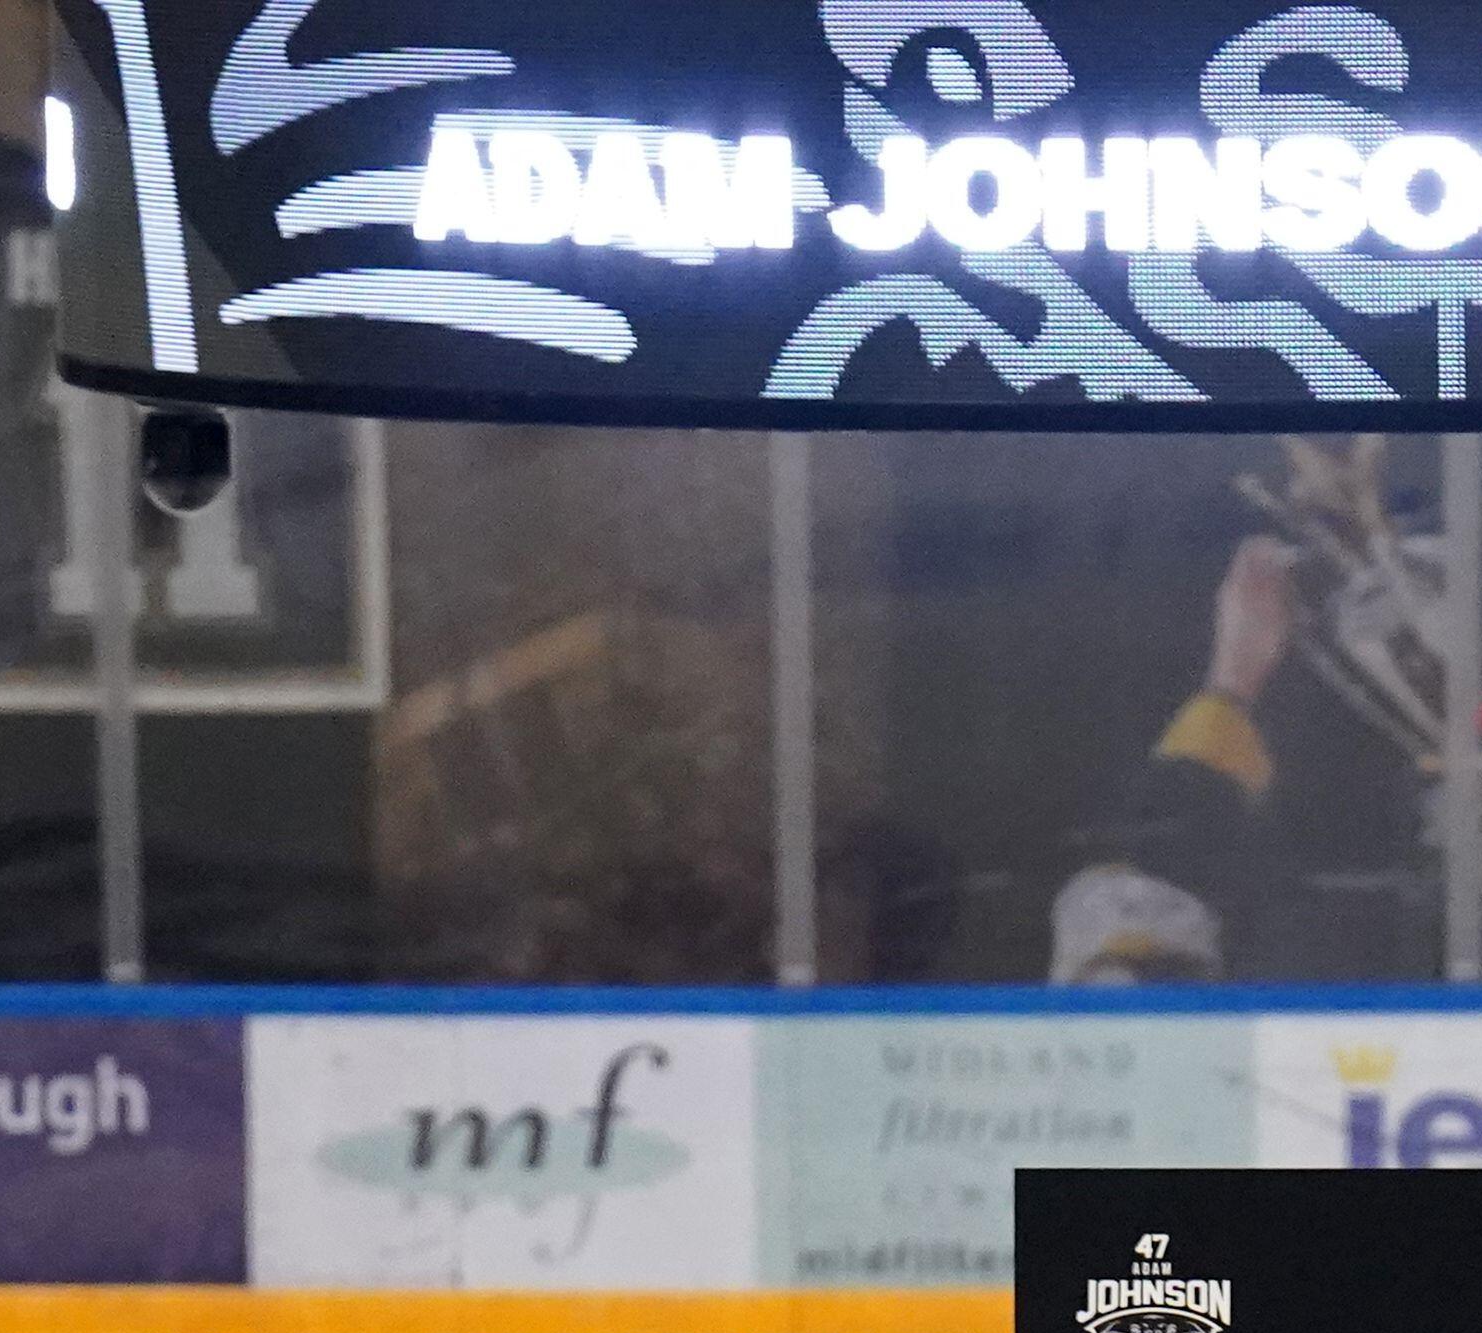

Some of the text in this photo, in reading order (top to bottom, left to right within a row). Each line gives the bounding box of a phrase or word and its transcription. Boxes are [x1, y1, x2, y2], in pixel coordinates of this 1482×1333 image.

[414, 130, 794, 248] ADAM
[1134, 1233, 1170, 1259] 47
[1131, 1261, 1173, 1276] ADAM
[1074, 1278, 1232, 1327] JOHNSON
